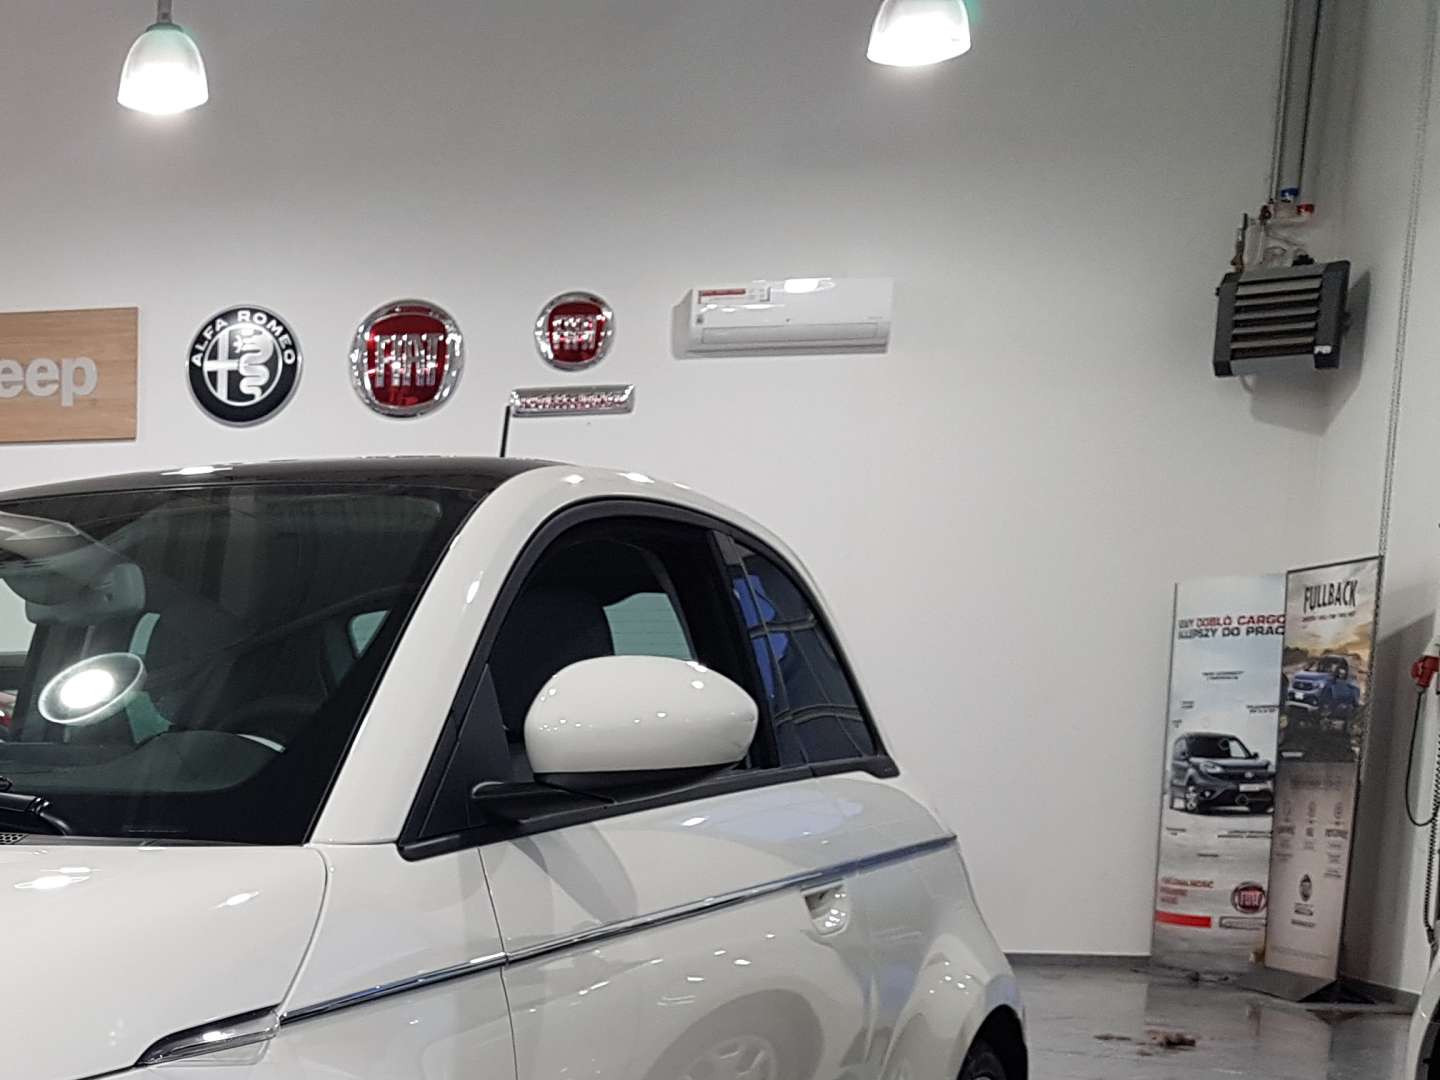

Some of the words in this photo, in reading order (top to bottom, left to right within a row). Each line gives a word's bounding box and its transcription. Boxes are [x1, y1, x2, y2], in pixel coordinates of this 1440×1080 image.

[191, 317, 229, 368] ALFA
[237, 309, 296, 365] ROMEO
[373, 332, 444, 388] FIAT
[1303, 579, 1358, 614] FULLBACK
[1222, 626, 1241, 638] DO
[1237, 613, 1286, 626] CARGO
